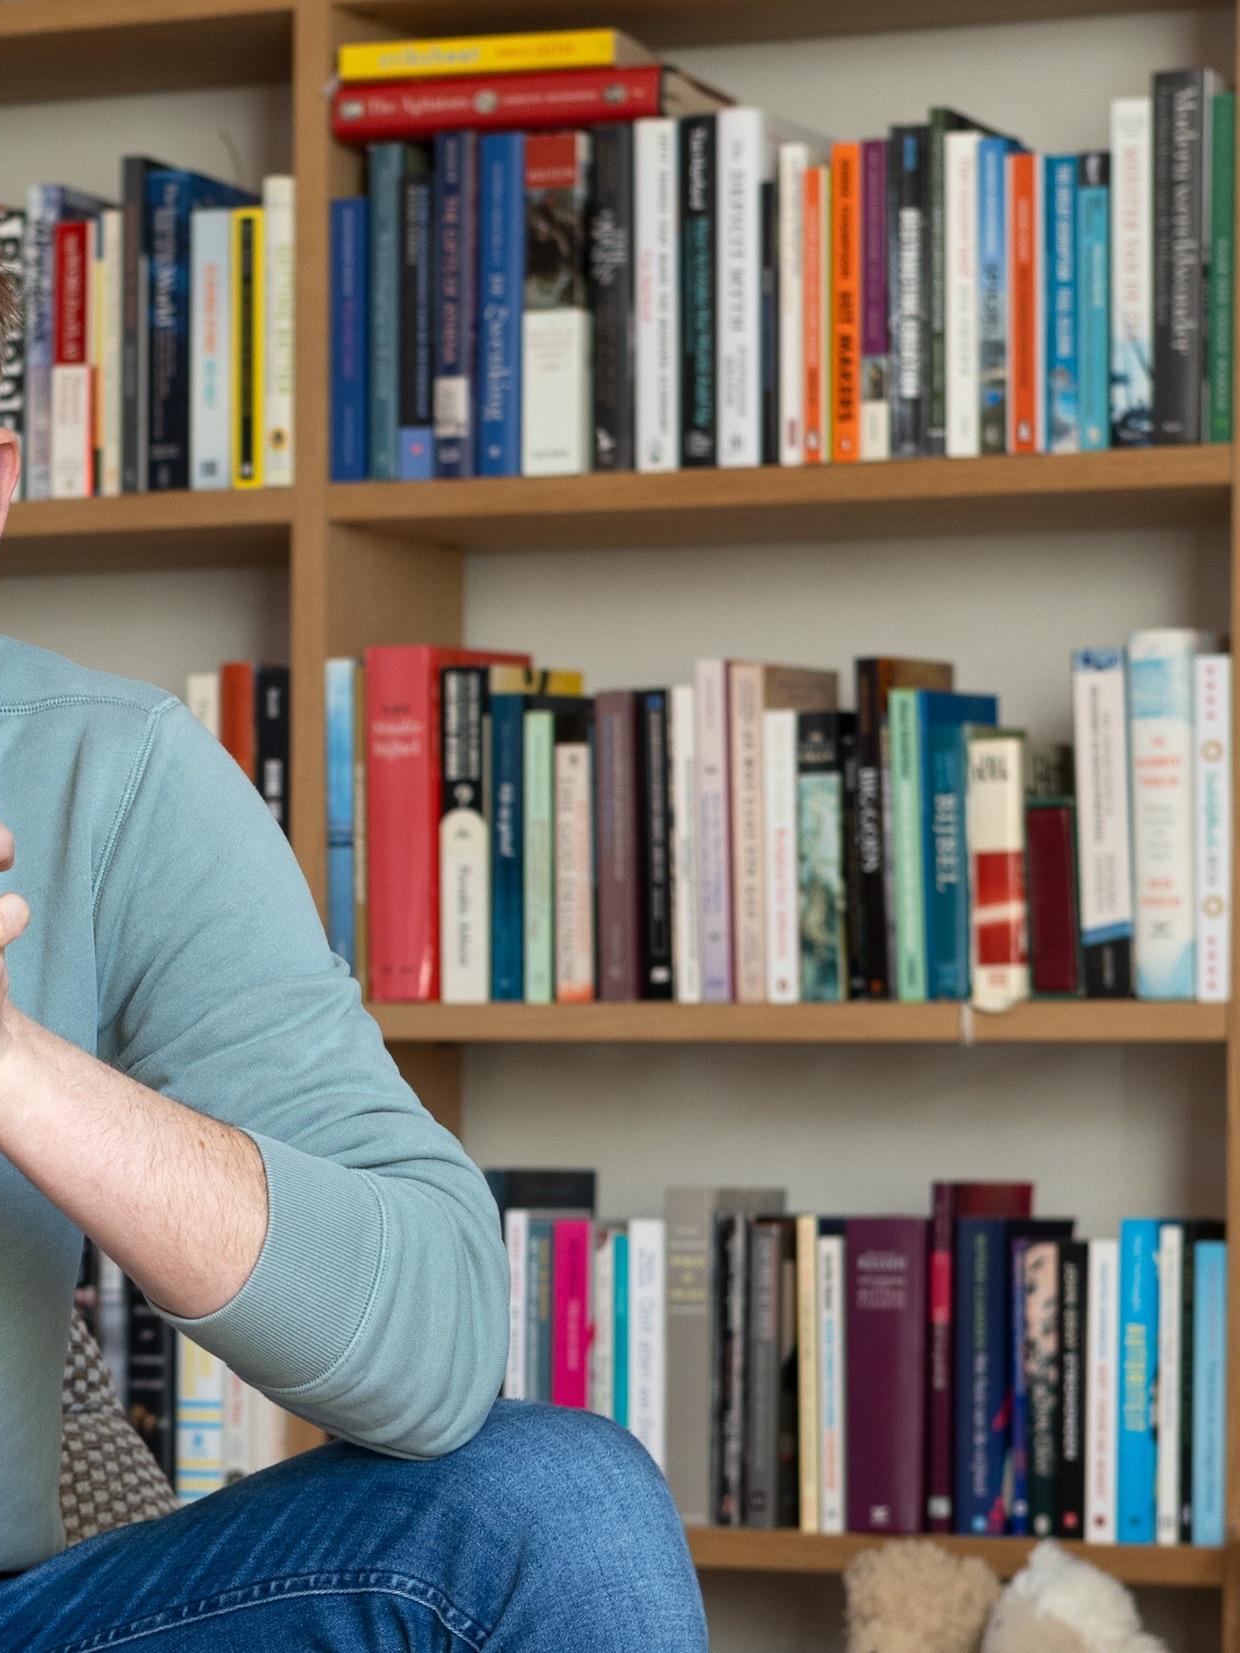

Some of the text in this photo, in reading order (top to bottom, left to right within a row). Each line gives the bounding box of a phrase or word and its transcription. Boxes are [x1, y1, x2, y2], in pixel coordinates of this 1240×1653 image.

[1170, 88, 1198, 354] Modern wereldwonder
[837, 333, 854, 424] MAKERS
[859, 768, 878, 873] BIG GODS
[934, 794, 957, 892] BIJBEL
[1063, 1262, 1078, 1349] JOHN GRAY
[1063, 1352, 1078, 1460] STROHONDEN
